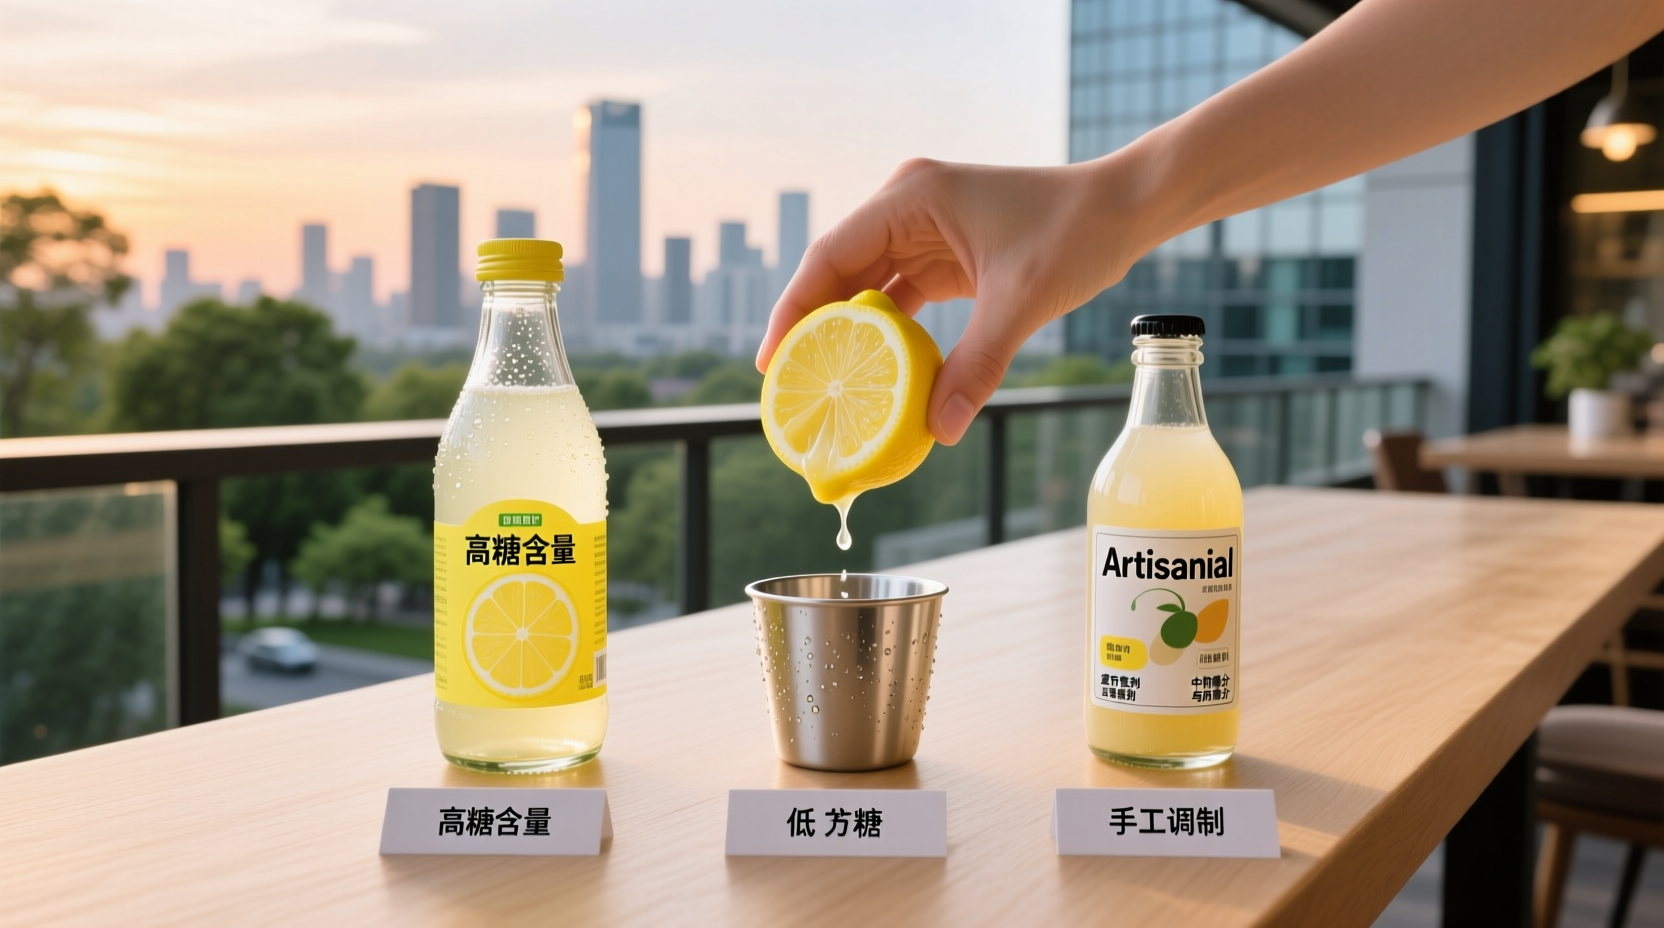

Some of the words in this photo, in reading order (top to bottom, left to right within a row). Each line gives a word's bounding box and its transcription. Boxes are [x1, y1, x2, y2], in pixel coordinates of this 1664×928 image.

[465, 533, 576, 566] 高糖含量
[1102, 546, 1234, 581] Artisanial
[438, 806, 552, 837] 高糖含量
[1108, 806, 1225, 837] 手工调制
